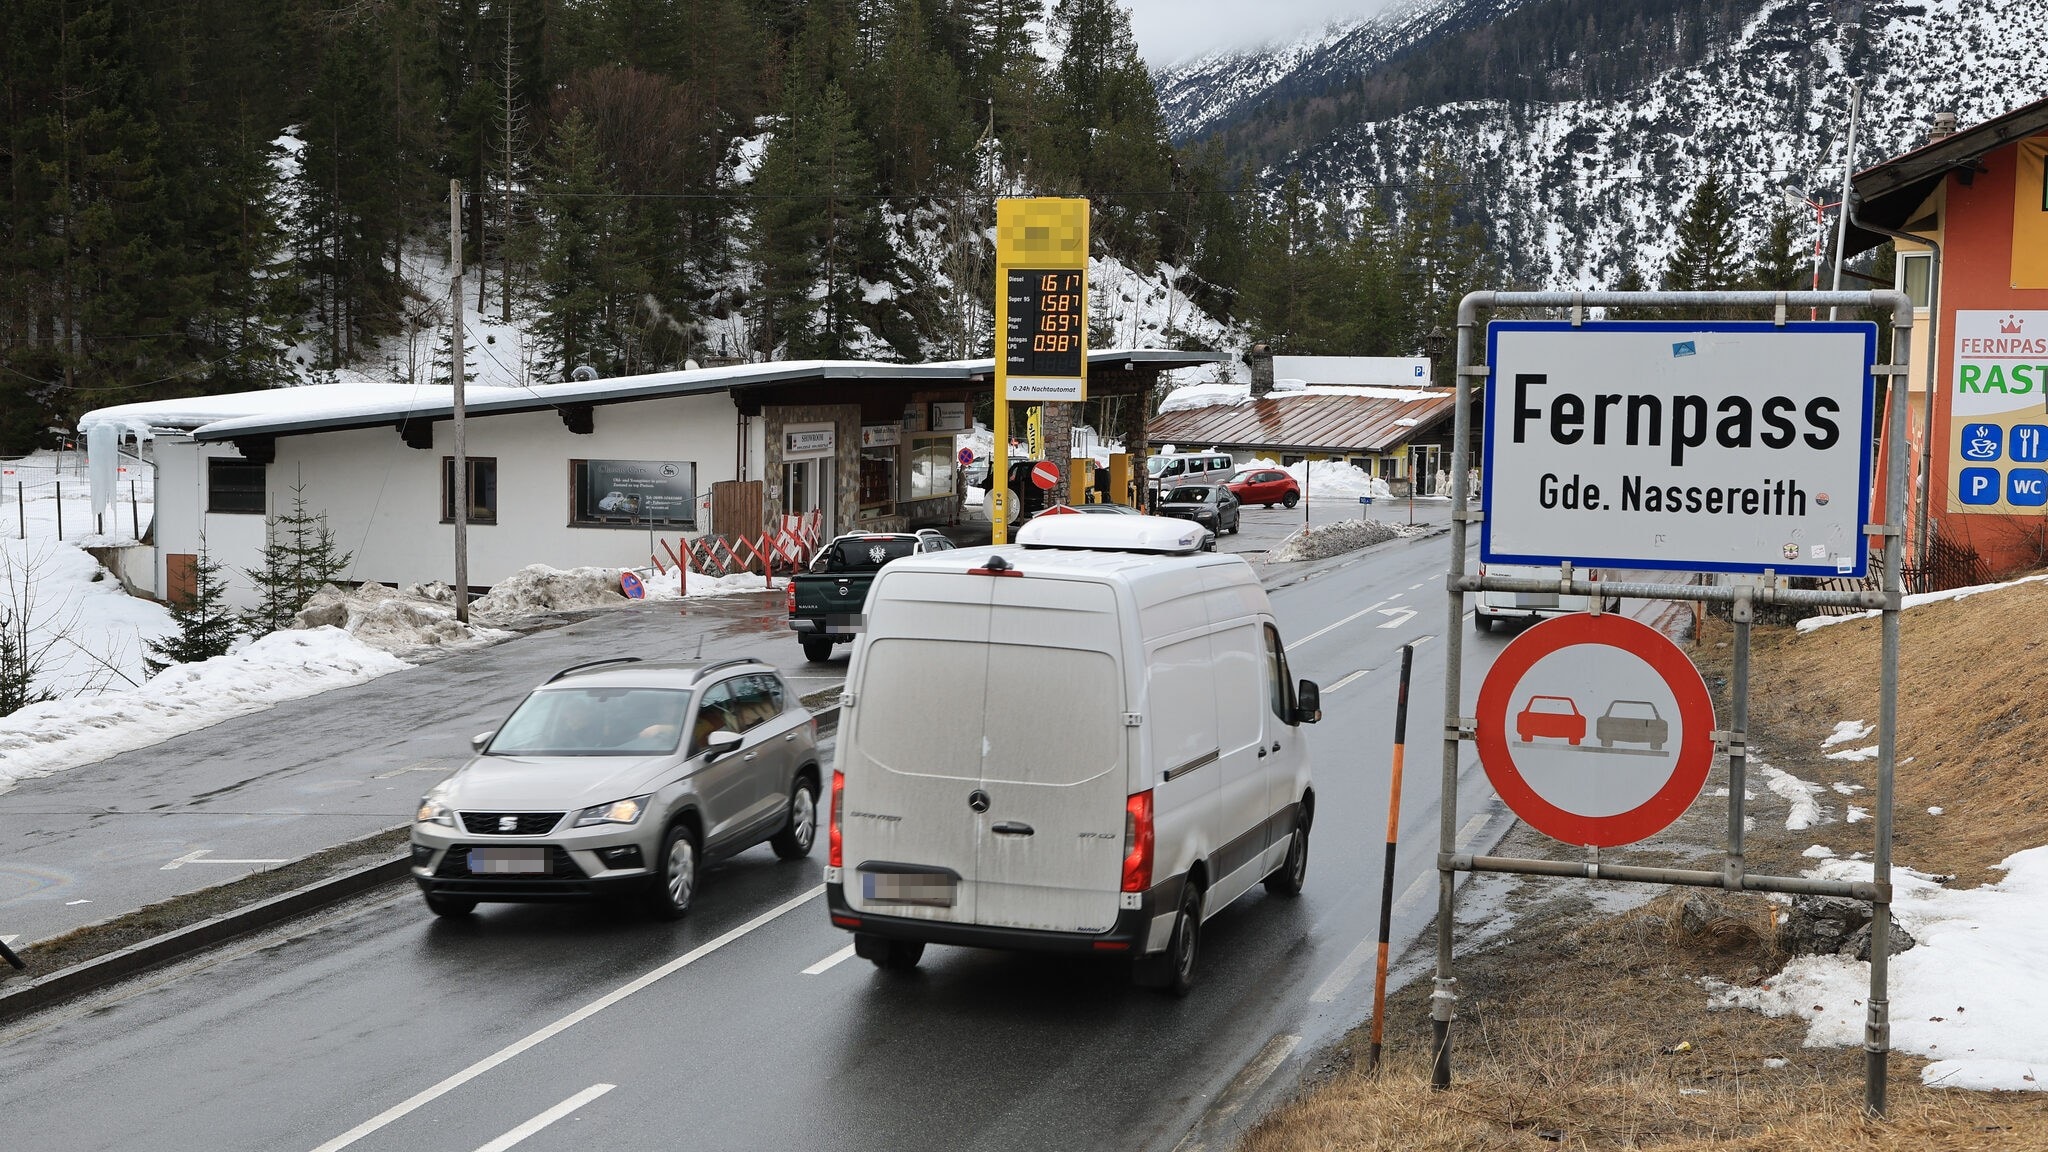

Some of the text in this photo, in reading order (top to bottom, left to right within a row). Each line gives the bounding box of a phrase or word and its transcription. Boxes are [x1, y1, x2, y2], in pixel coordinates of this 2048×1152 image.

[1007, 336, 1028, 344] Autogas
[1513, 373, 1840, 467] Fernpass
[1539, 473, 1807, 517] Gde. Nassereith
[1972, 476, 2042, 496] P WC
